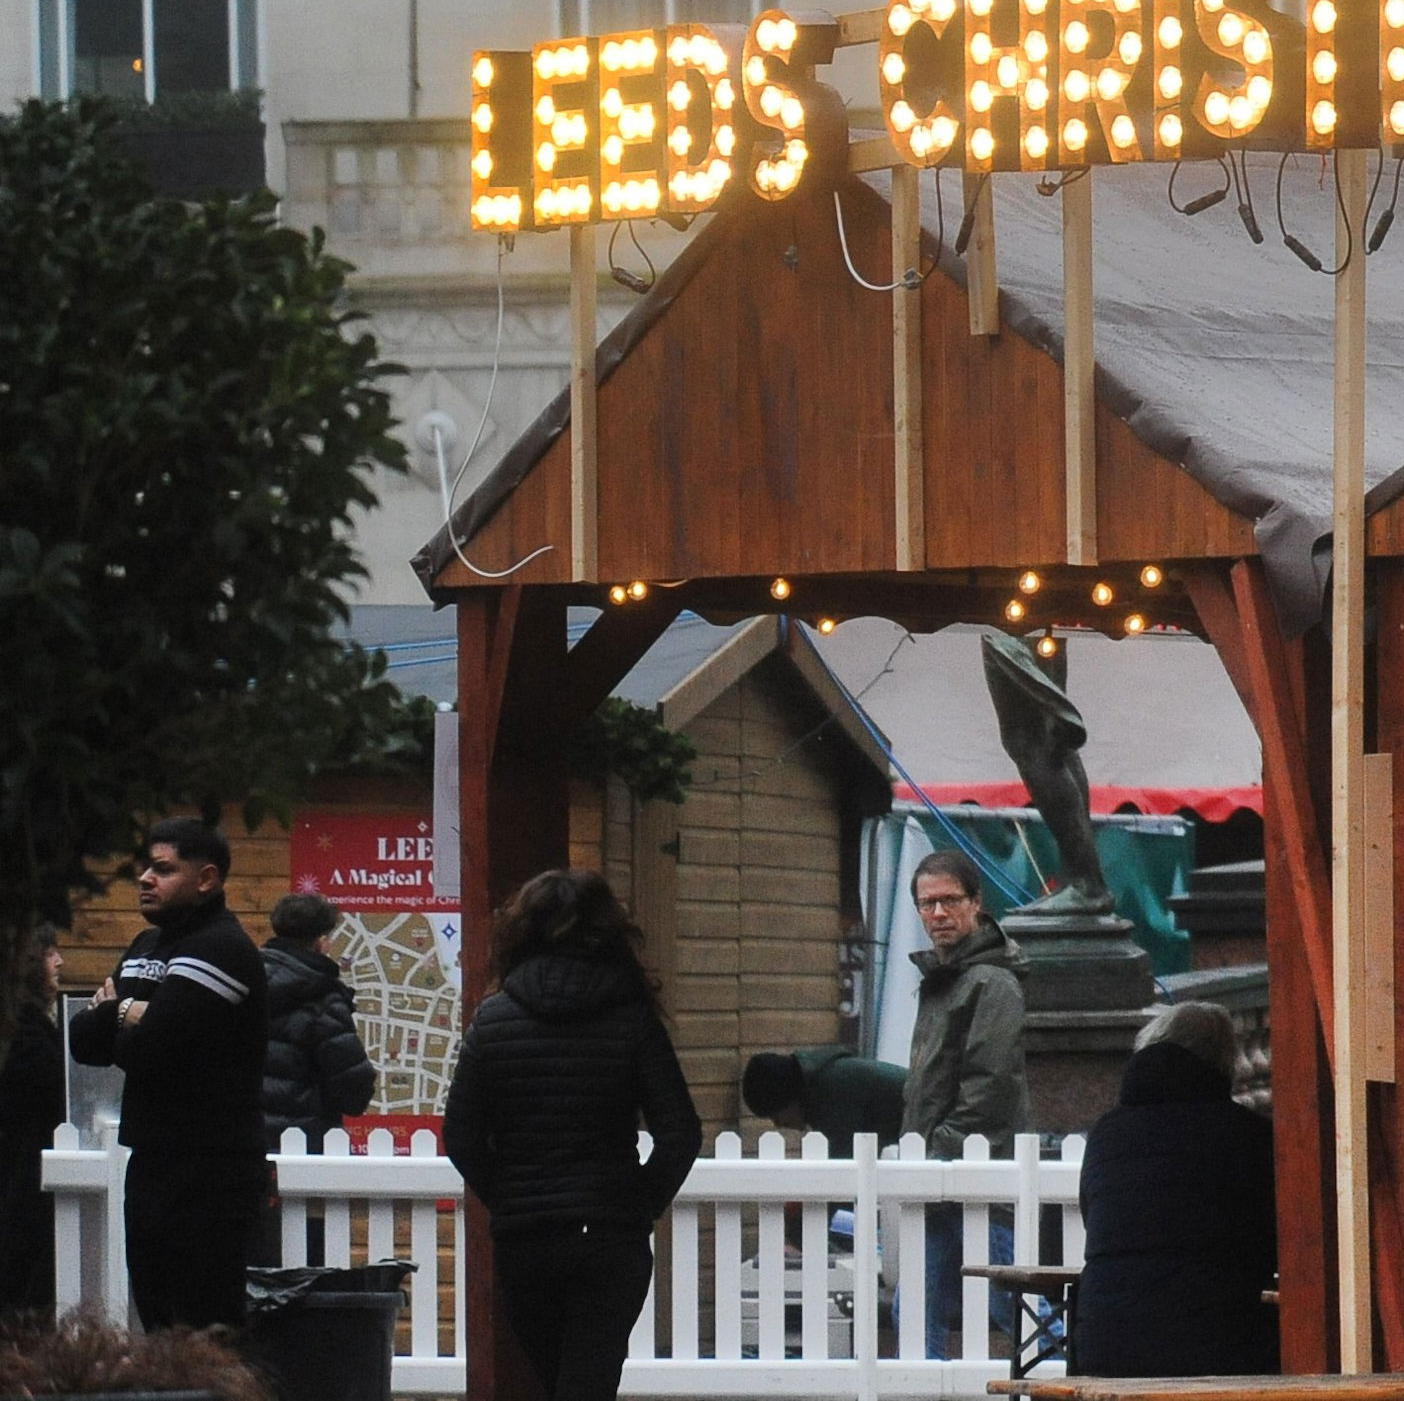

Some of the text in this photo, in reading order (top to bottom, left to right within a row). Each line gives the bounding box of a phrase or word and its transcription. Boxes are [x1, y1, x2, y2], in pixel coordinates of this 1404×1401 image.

[472, 9, 815, 232] LEEDS
[377, 837, 433, 861] LEE
[329, 869, 344, 885] A
[349, 869, 422, 889] Magical
[322, 895, 374, 905] xperience
[376, 895, 392, 904] the
[395, 895, 424, 906] magic
